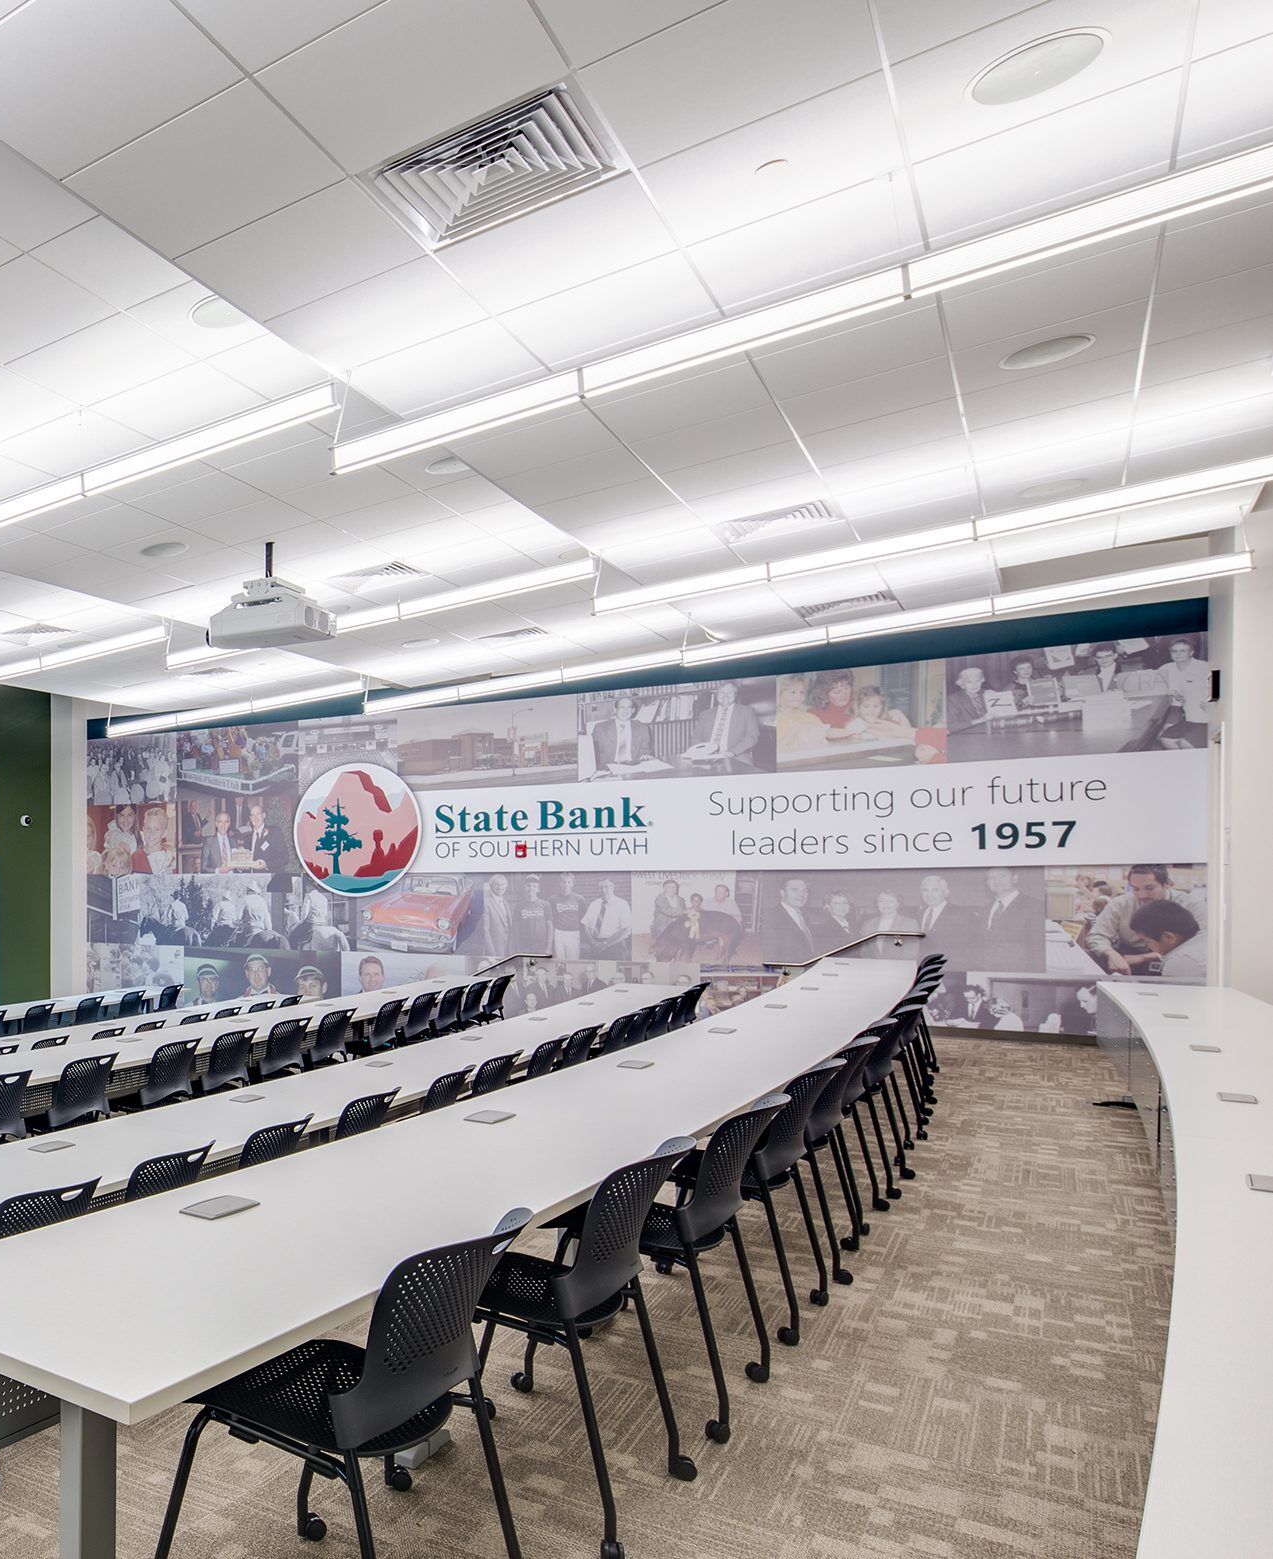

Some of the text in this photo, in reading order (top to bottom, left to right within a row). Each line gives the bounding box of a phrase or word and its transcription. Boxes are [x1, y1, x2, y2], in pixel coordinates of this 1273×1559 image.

[434, 796, 647, 834] State Bank
[709, 775, 1107, 822] Supporting our future
[435, 837, 648, 859] OF SOUTHERN UTAH
[732, 819, 1077, 856] leaders since 1957
